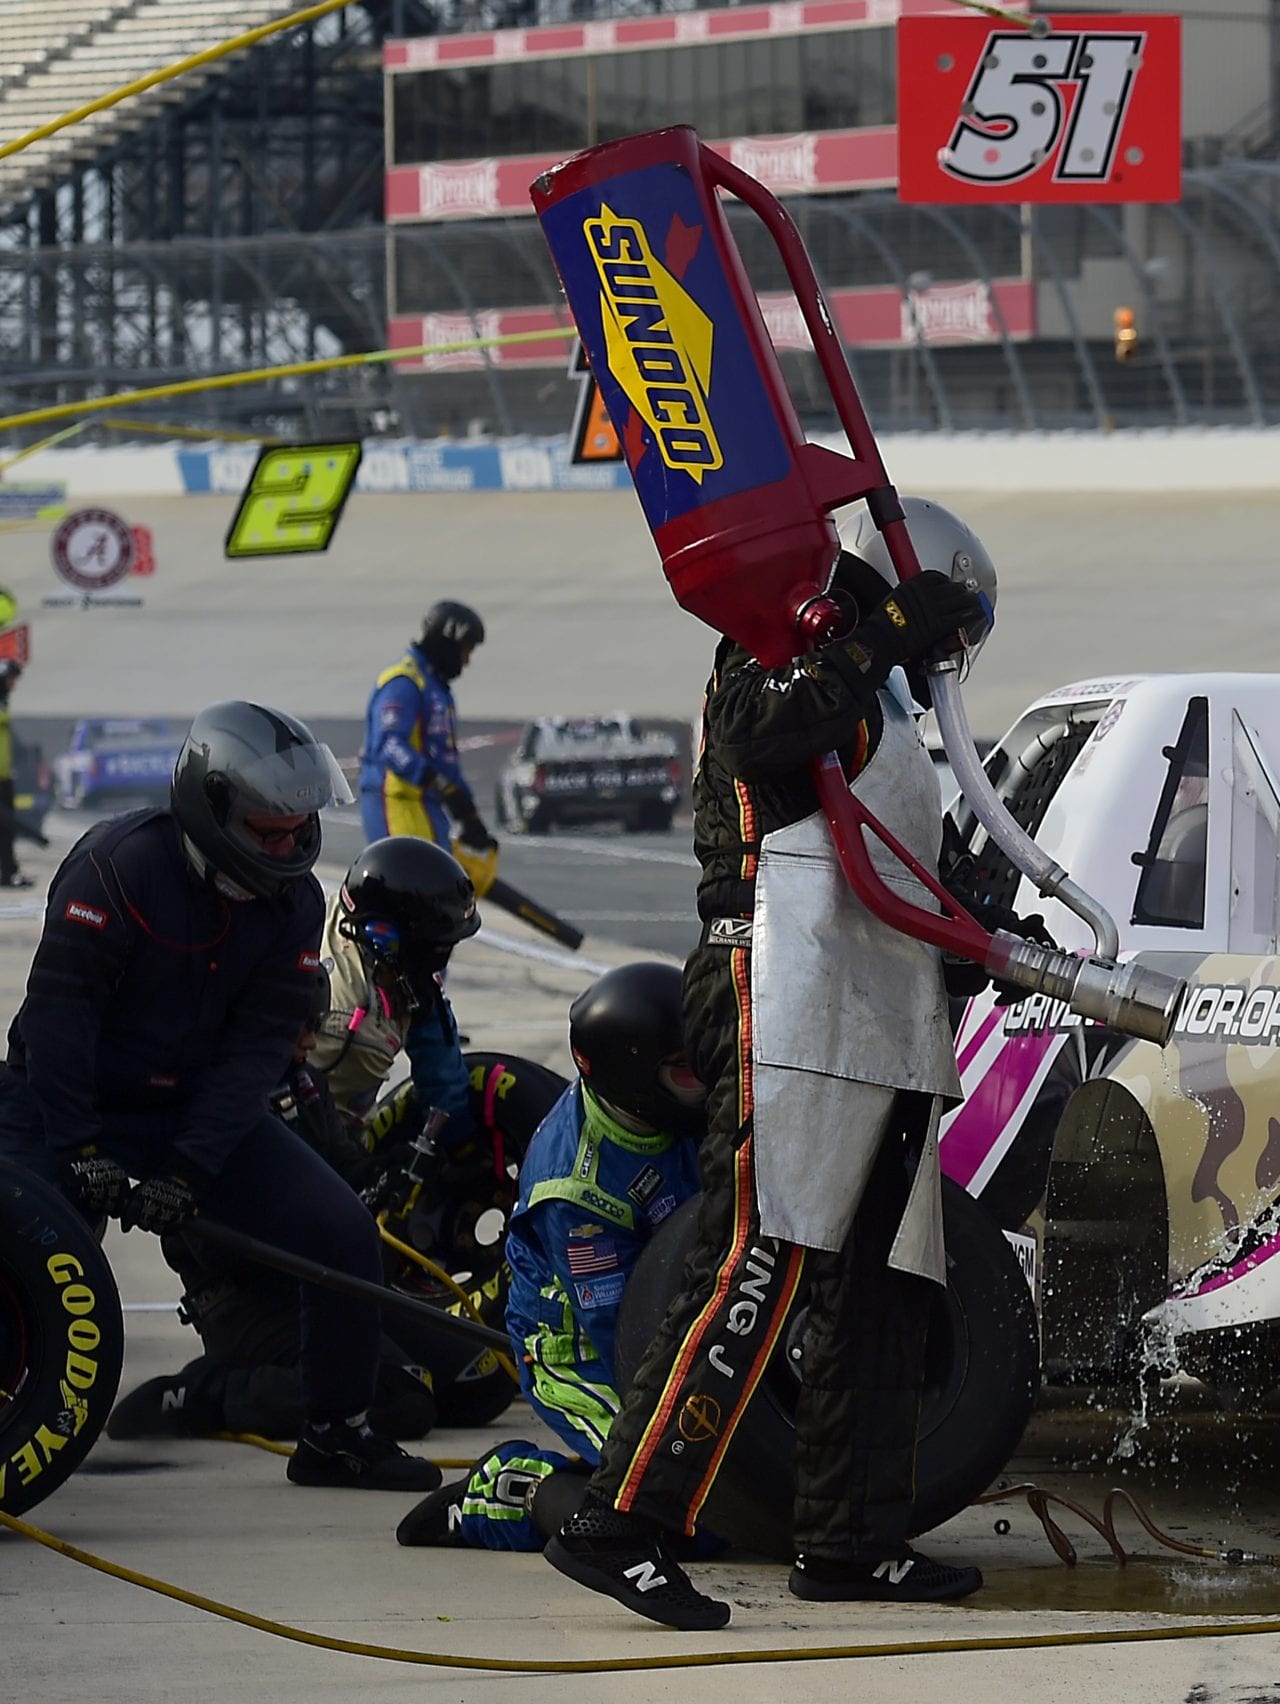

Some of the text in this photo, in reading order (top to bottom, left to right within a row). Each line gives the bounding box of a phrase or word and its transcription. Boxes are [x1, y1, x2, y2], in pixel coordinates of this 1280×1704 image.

[938, 30, 1147, 186] 51
[588, 223, 717, 465] SUNOCO
[226, 442, 360, 557] 2
[726, 1238, 779, 1336] ING
[0, 1252, 101, 1500] GOODYE
